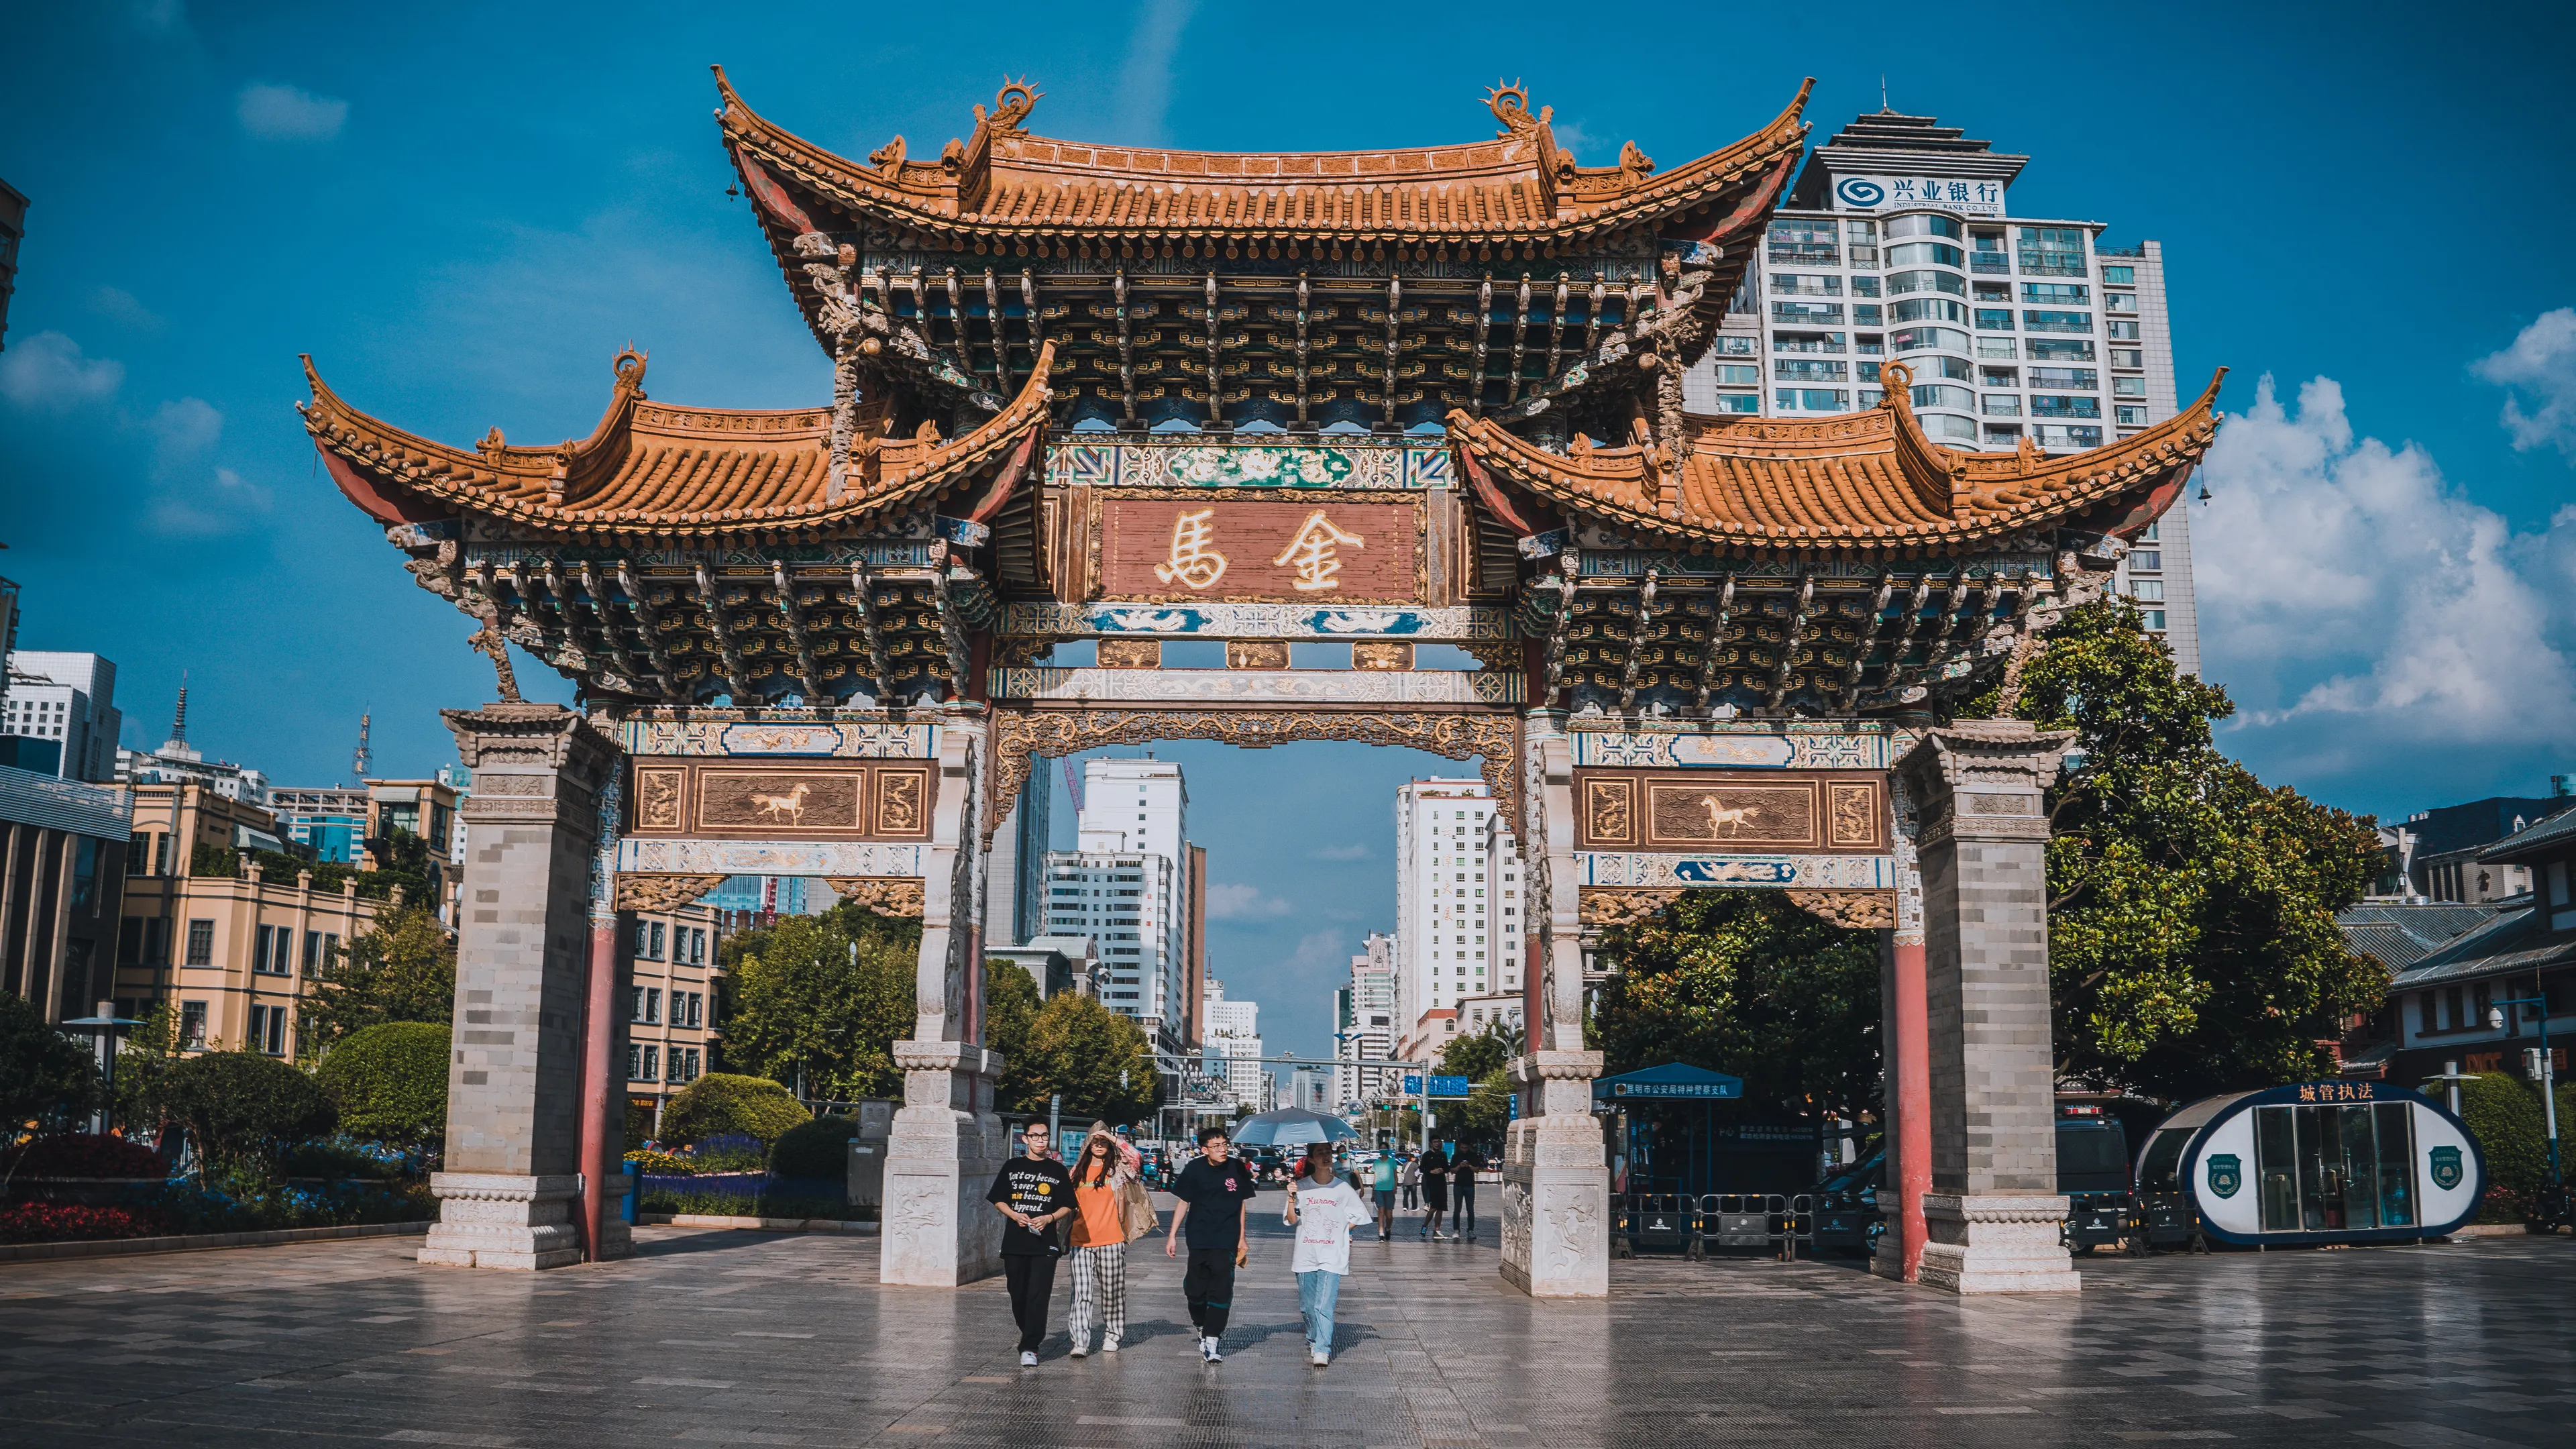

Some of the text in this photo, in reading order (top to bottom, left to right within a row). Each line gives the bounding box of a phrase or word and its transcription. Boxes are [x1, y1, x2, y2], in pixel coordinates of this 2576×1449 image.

[1893, 178, 1998, 203] 兴业银行
[1627, 1084, 1728, 1095] 昆明市公安局特种警察支队
[2299, 1083, 2373, 1102] 城管执法
[1024, 1173, 1036, 1182] cry
[1023, 1191, 1052, 1203] because
